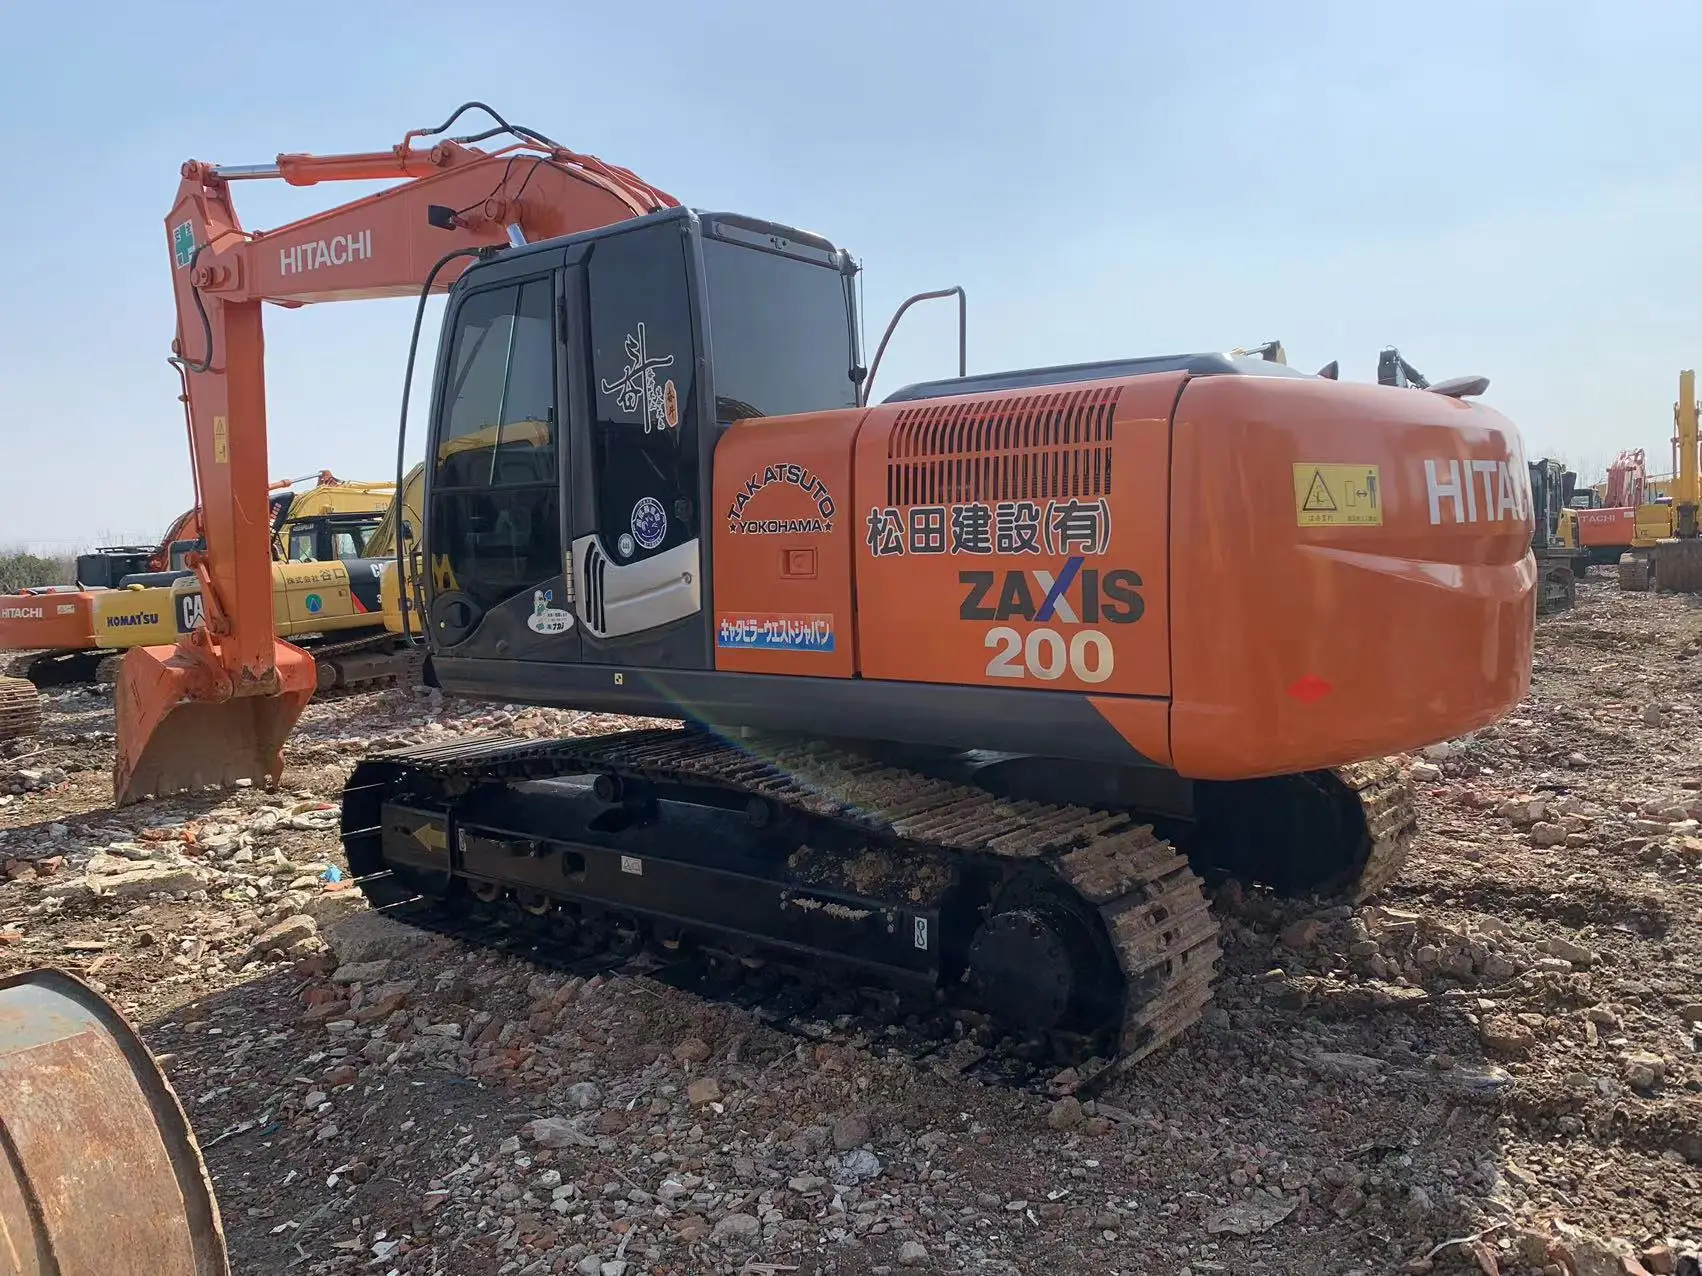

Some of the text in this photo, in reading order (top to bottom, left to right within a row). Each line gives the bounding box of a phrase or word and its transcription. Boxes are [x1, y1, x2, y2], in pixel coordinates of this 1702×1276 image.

[280, 229, 372, 276] HITACHI
[727, 463, 836, 521] TAKATSUTO
[738, 520, 824, 535] YOKOHAMA
[1580, 513, 1616, 523] TACHI
[959, 557, 1145, 624] ZAXIS
[0, 607, 43, 619] HITACHI
[183, 594, 207, 629] CA
[984, 626, 1114, 684] 200
